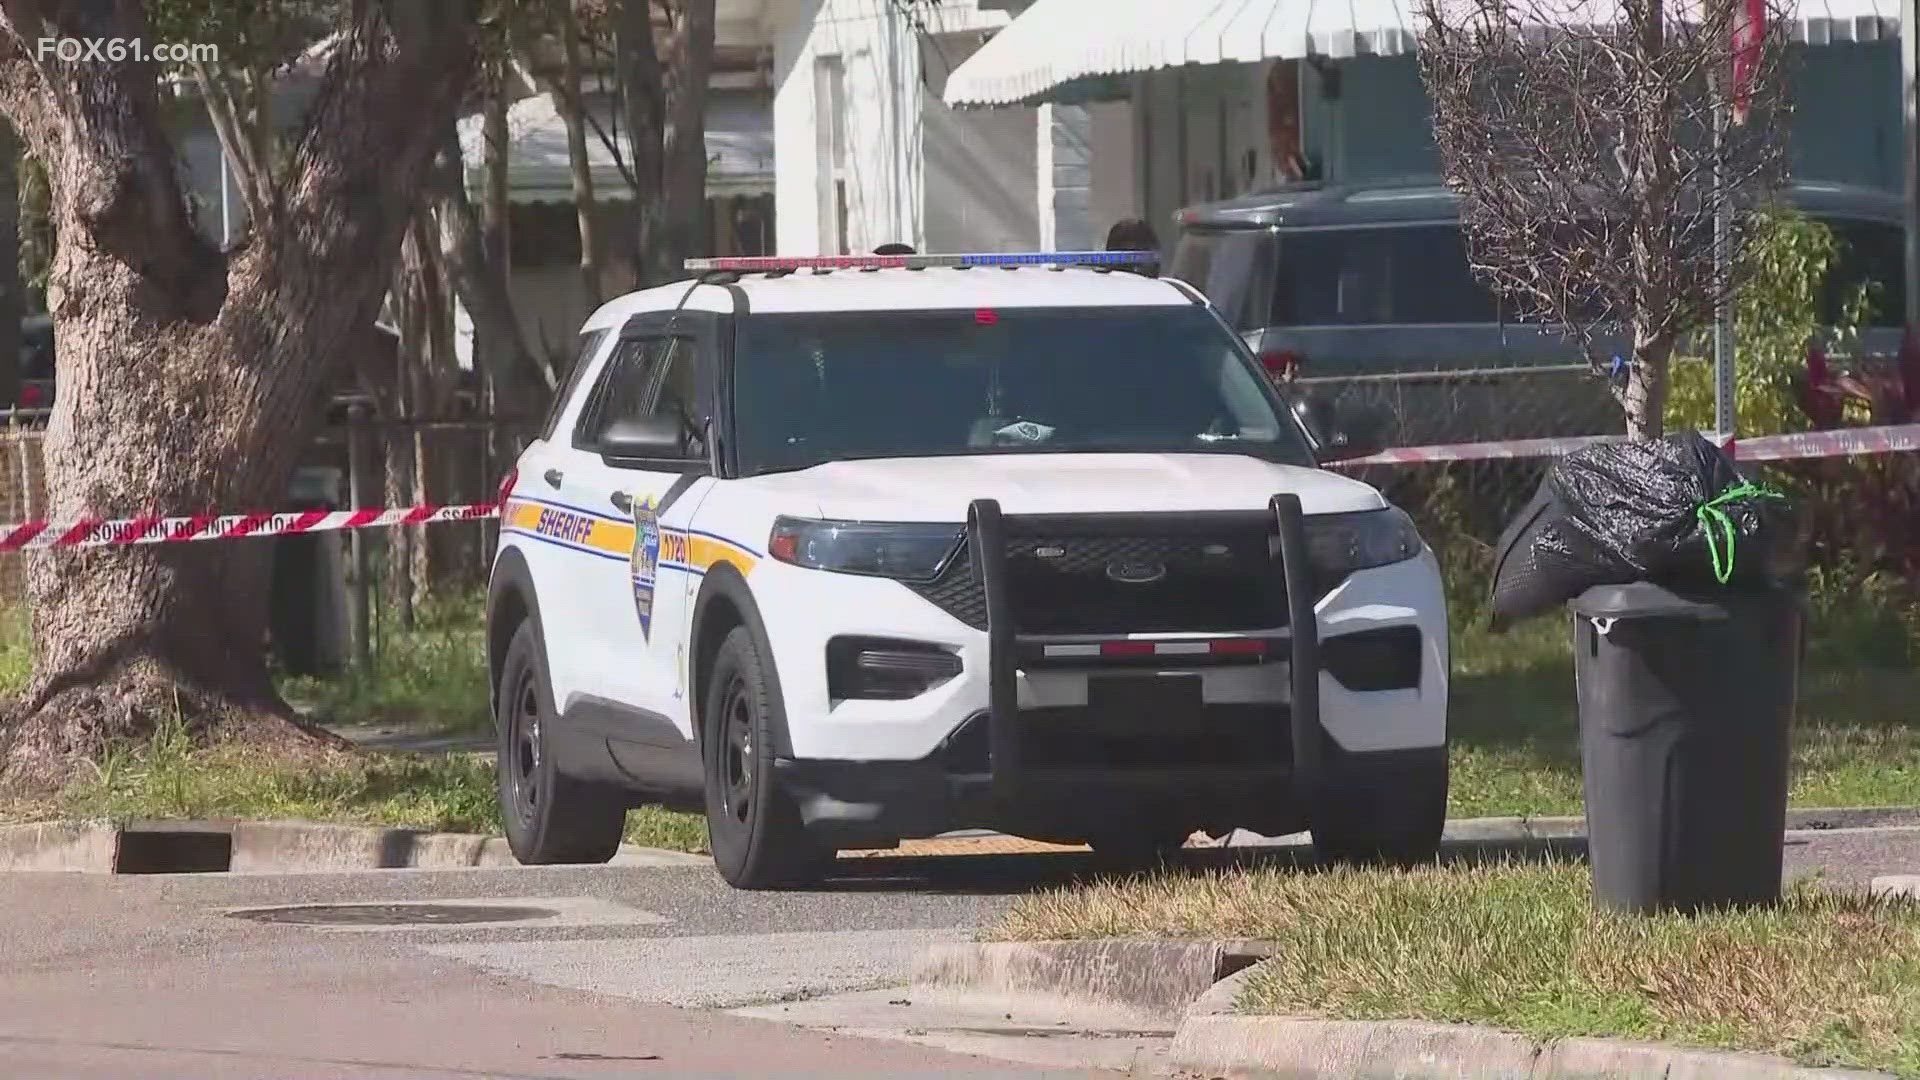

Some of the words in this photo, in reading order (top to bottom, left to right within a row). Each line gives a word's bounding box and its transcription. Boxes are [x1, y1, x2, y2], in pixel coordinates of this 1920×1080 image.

[142, 519, 169, 539] NOT
[175, 518, 196, 537] DO
[536, 508, 595, 544] SHERIFF
[664, 533, 686, 563] 1720
